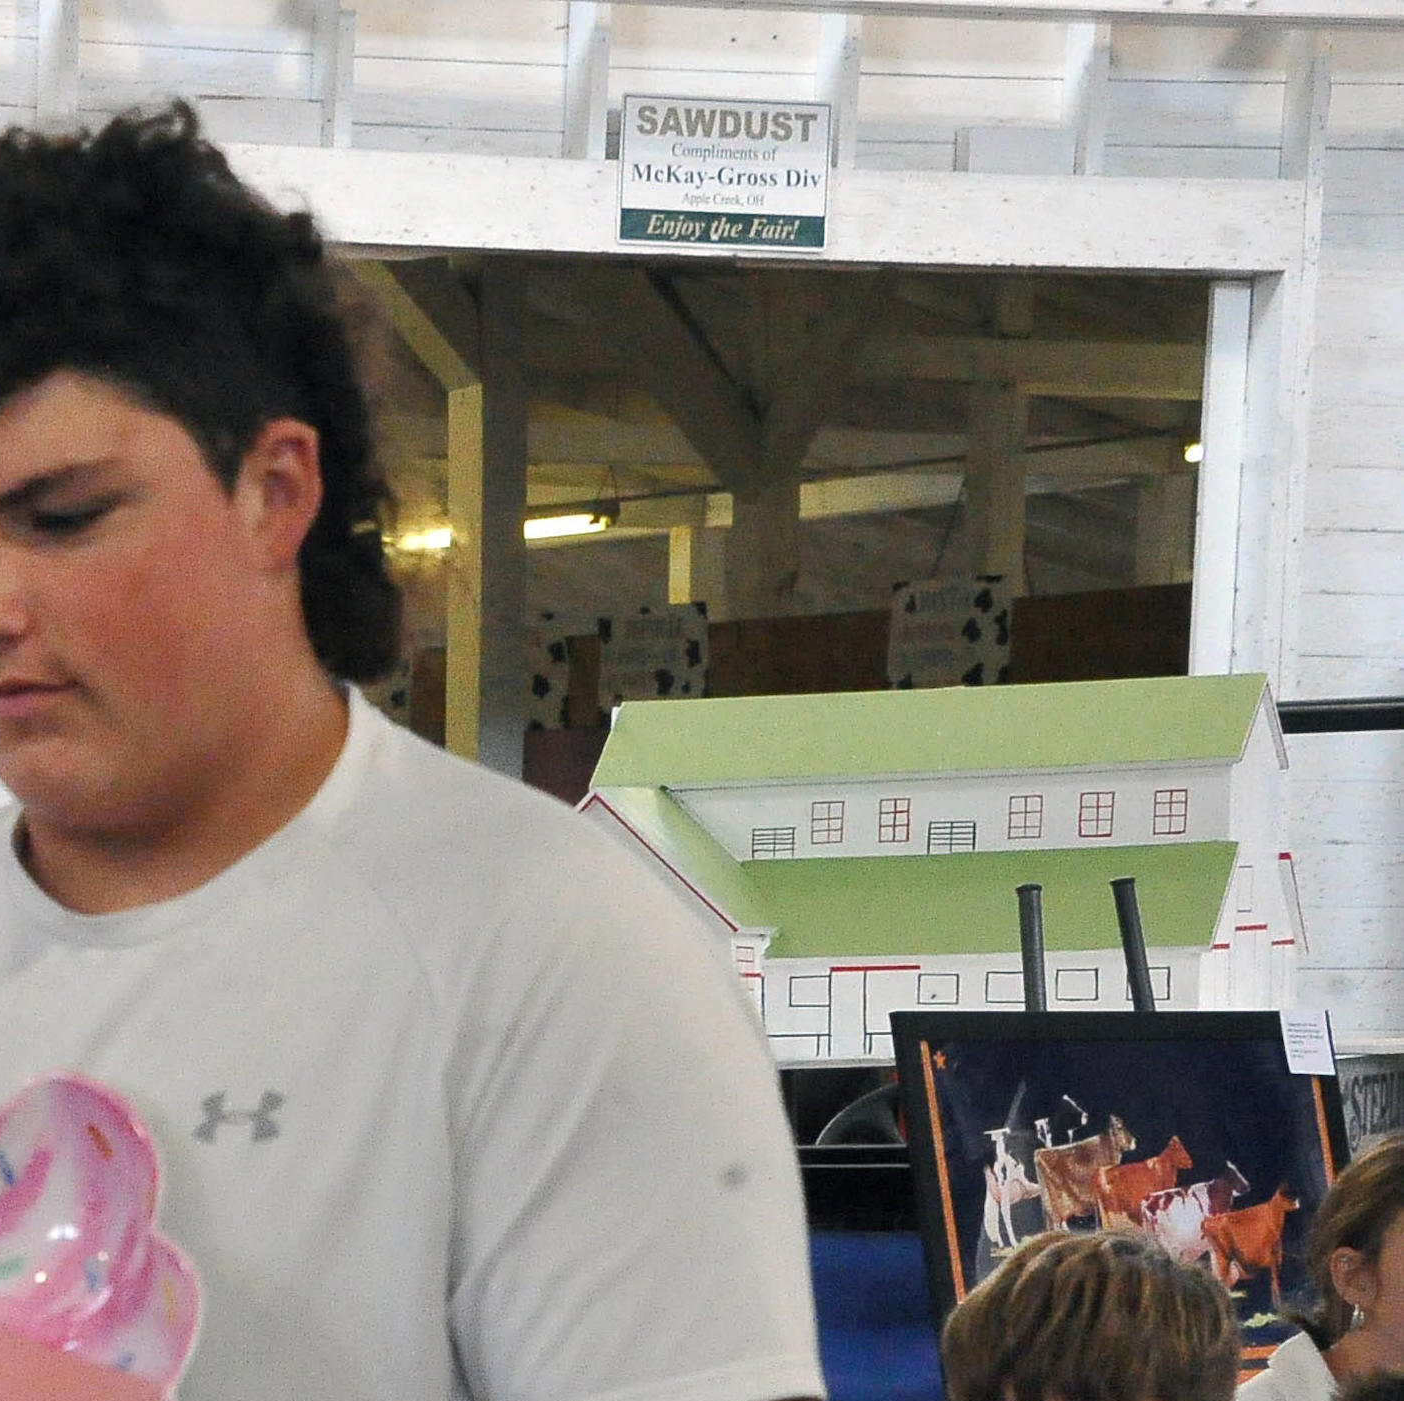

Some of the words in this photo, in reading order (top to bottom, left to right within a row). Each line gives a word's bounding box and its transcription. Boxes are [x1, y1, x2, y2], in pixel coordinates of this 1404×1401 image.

[636, 105, 818, 143] SAWDUST
[671, 142, 759, 163] Compliments
[761, 146, 779, 162] of
[631, 163, 778, 189] McKay-Gross
[785, 169, 822, 189] Div
[647, 213, 706, 239] Enjoy
[709, 216, 743, 240] the
[748, 218, 801, 241] Fair!
